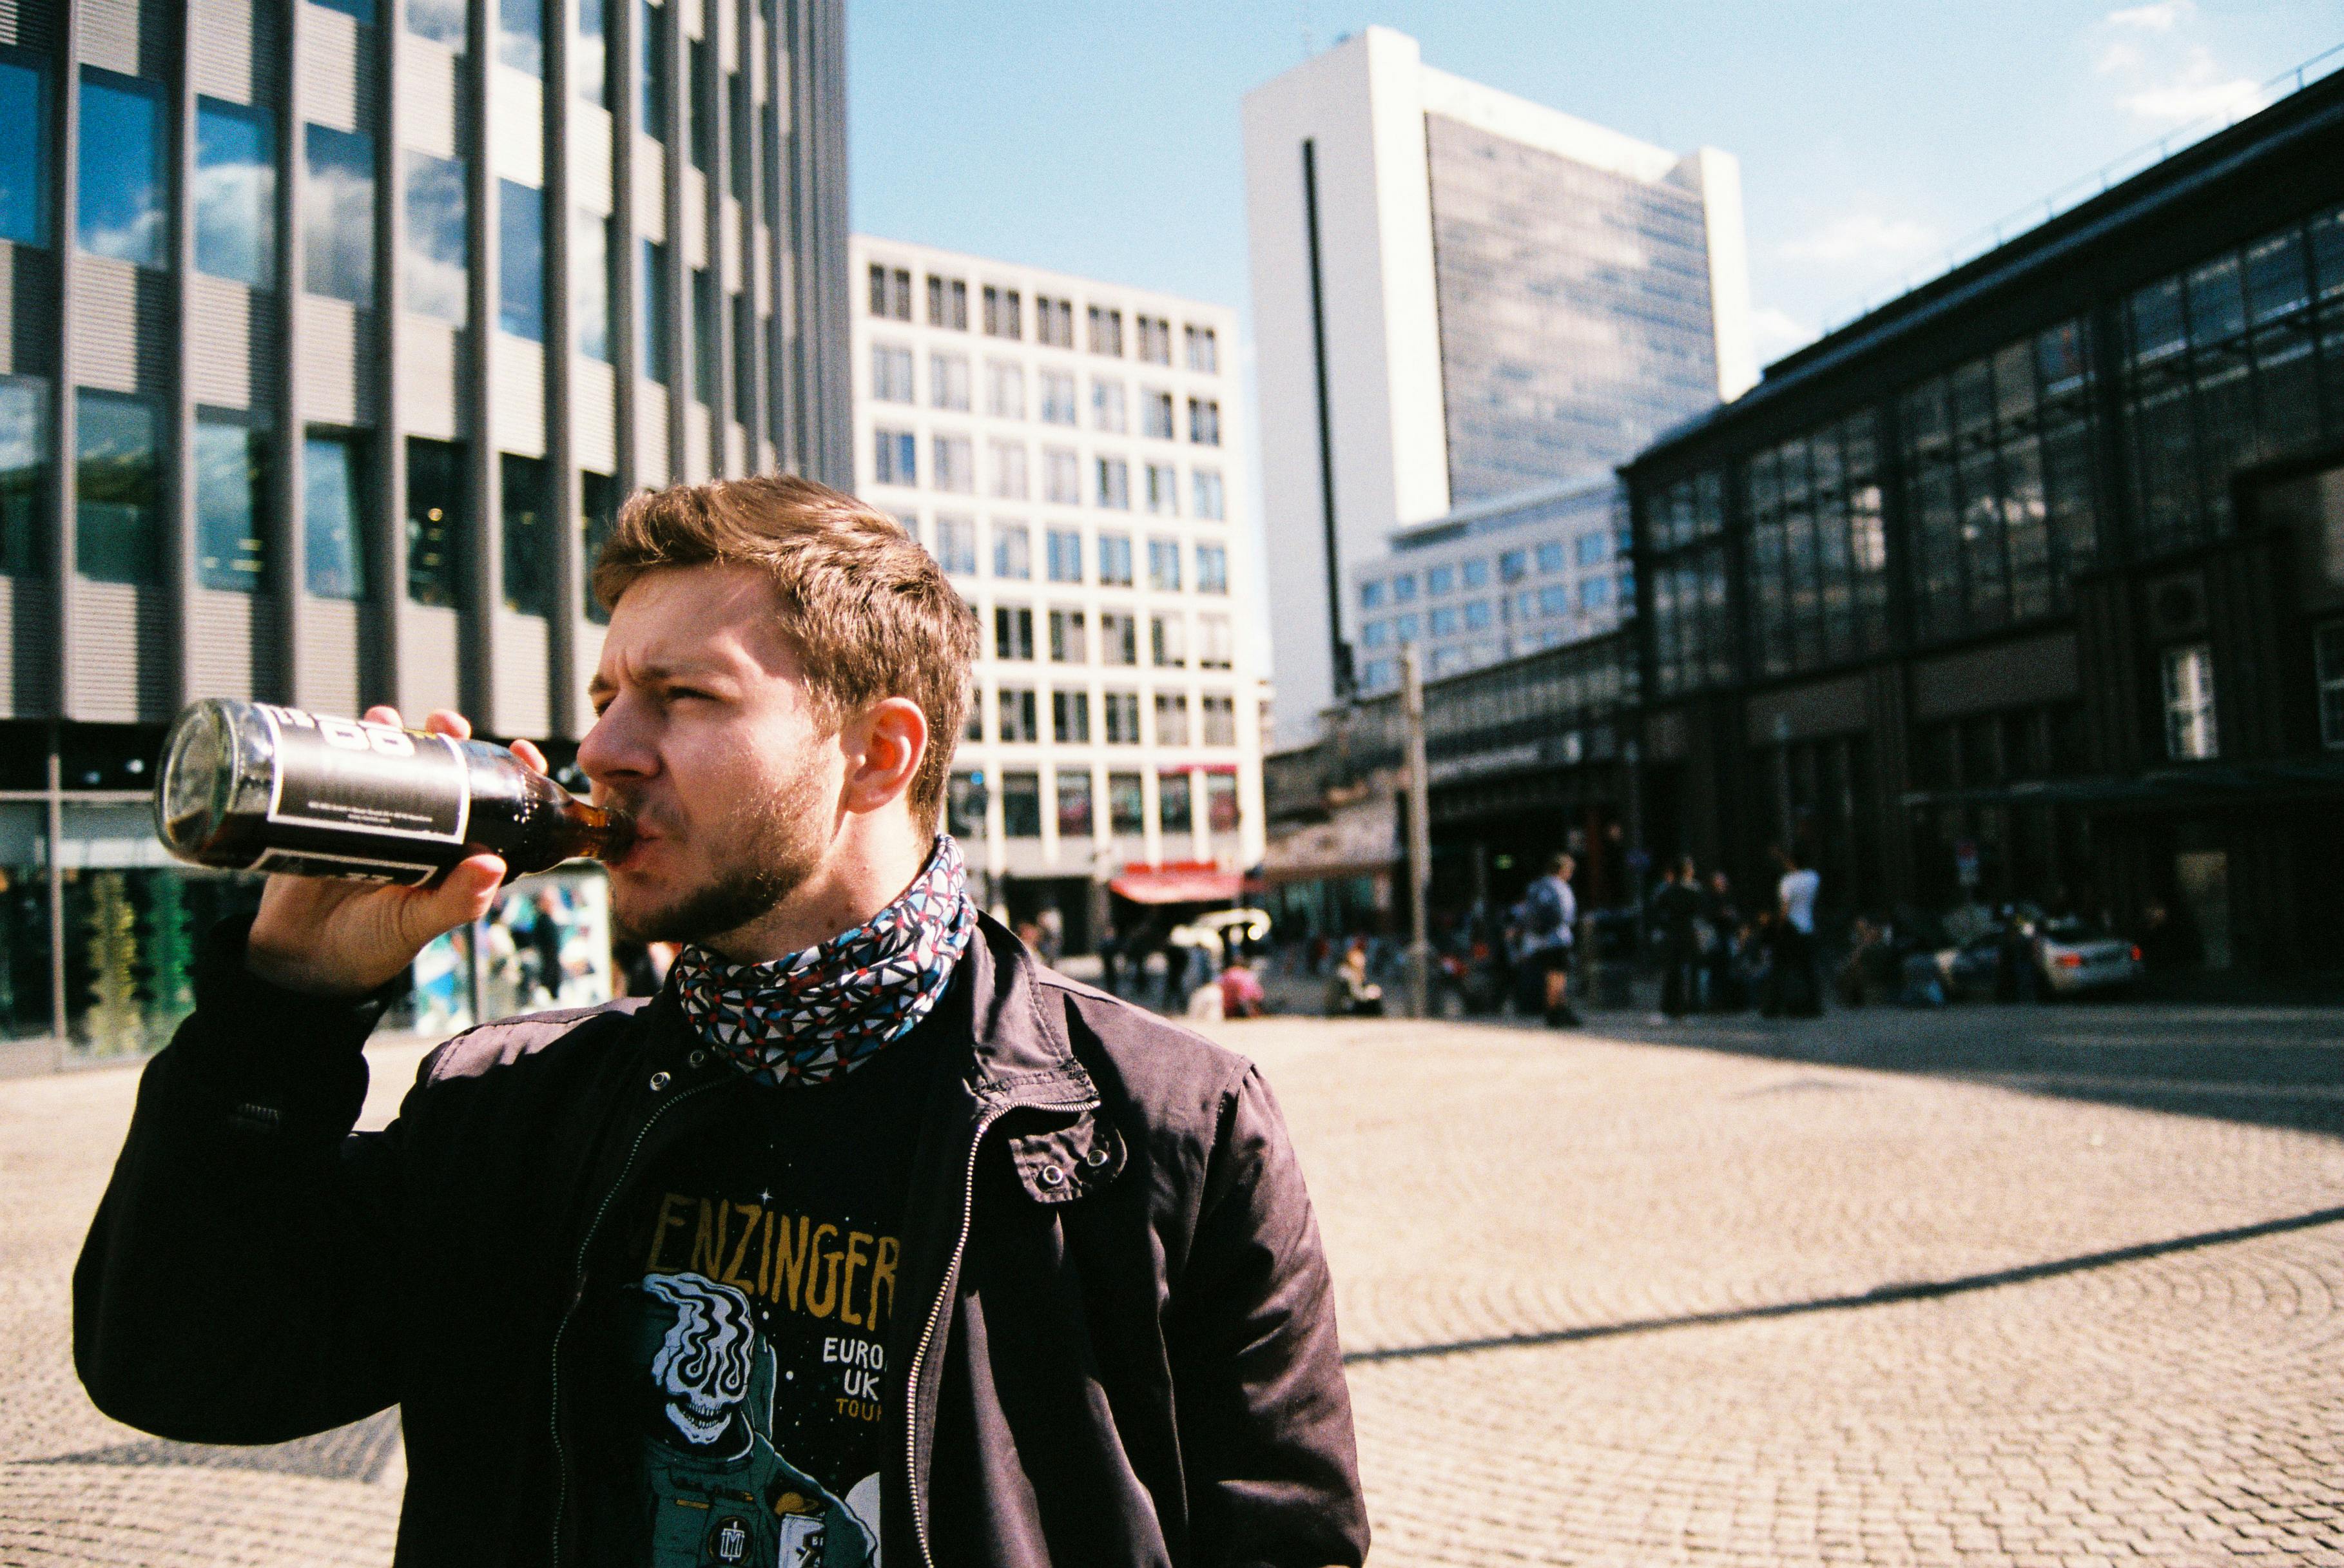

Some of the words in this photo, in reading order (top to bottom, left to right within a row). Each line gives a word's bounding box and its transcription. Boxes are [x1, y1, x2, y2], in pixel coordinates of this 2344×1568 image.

[646, 1192, 900, 1332] ENZINGER
[823, 1337, 884, 1370] EURO
[844, 1368, 880, 1402] UK
